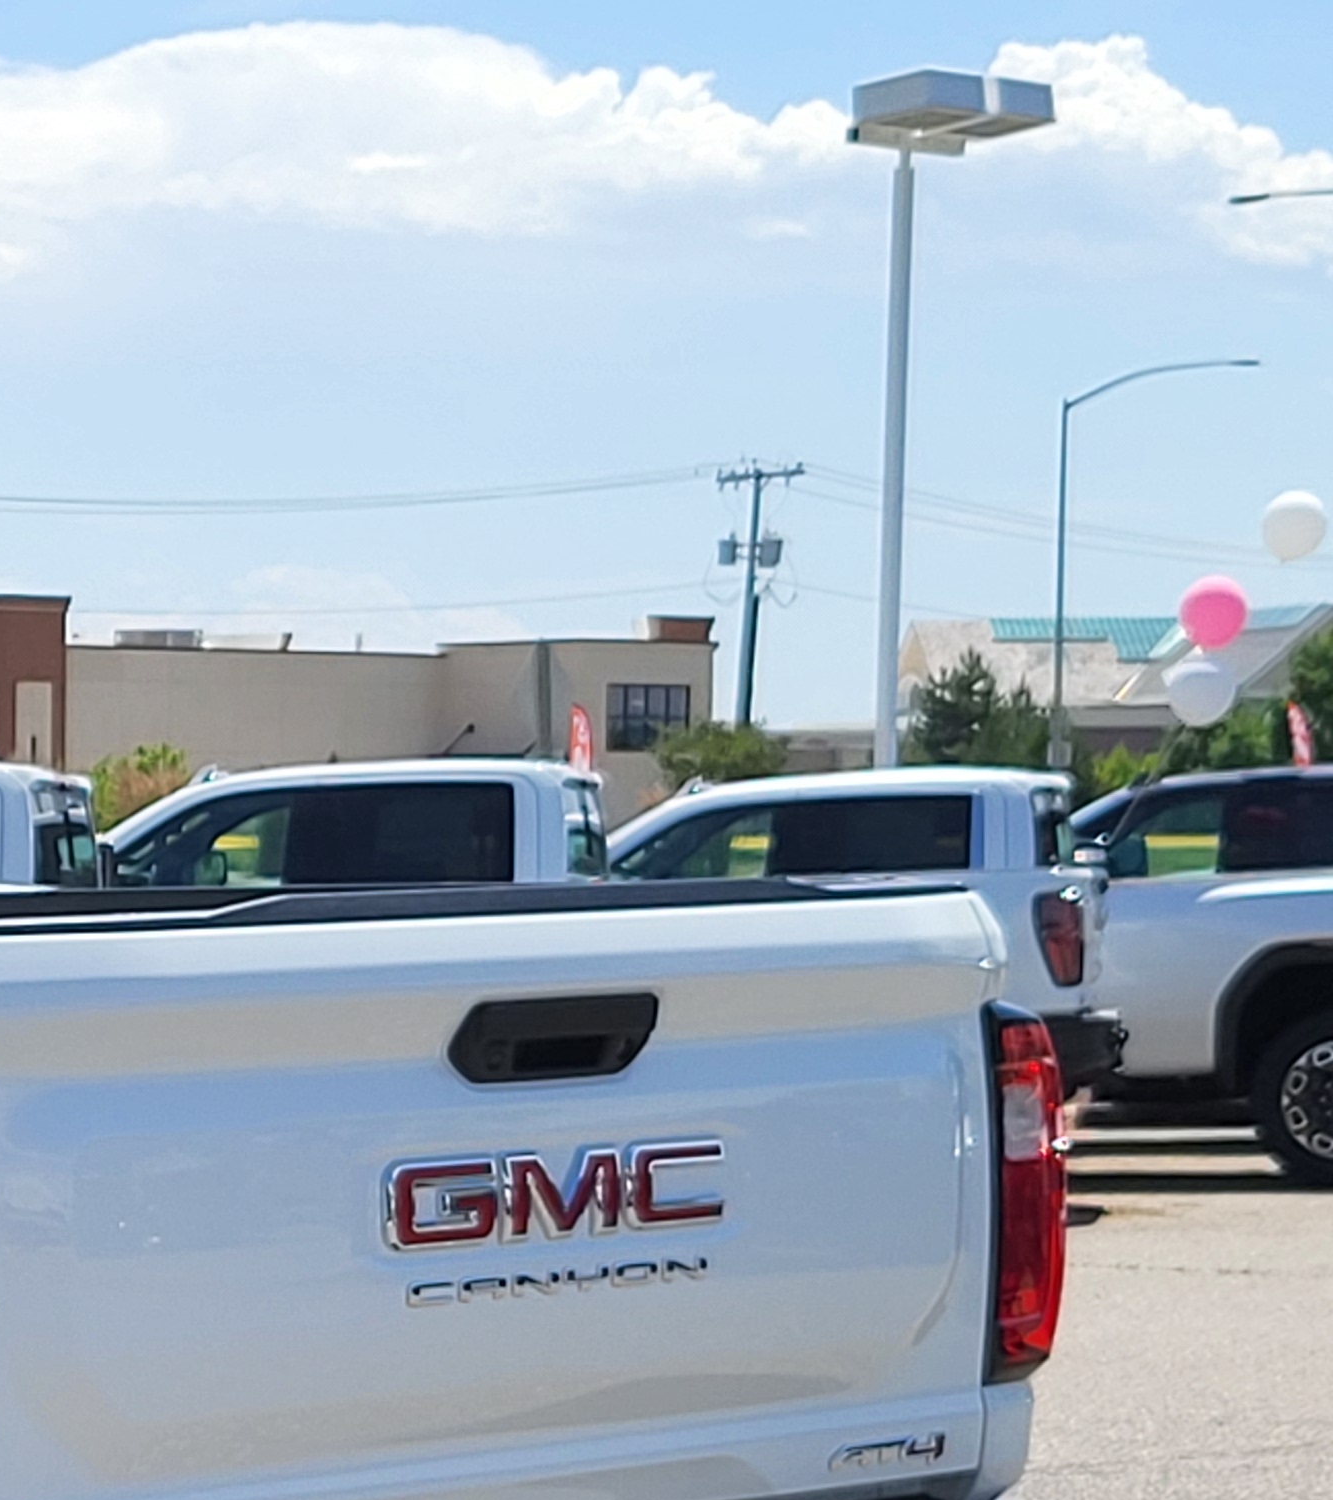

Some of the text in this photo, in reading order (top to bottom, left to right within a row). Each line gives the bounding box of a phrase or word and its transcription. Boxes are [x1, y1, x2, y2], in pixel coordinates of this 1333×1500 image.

[385, 1139, 725, 1250] GMC
[406, 1256, 708, 1307] CANYON
[828, 1432, 945, 1471] AT4
